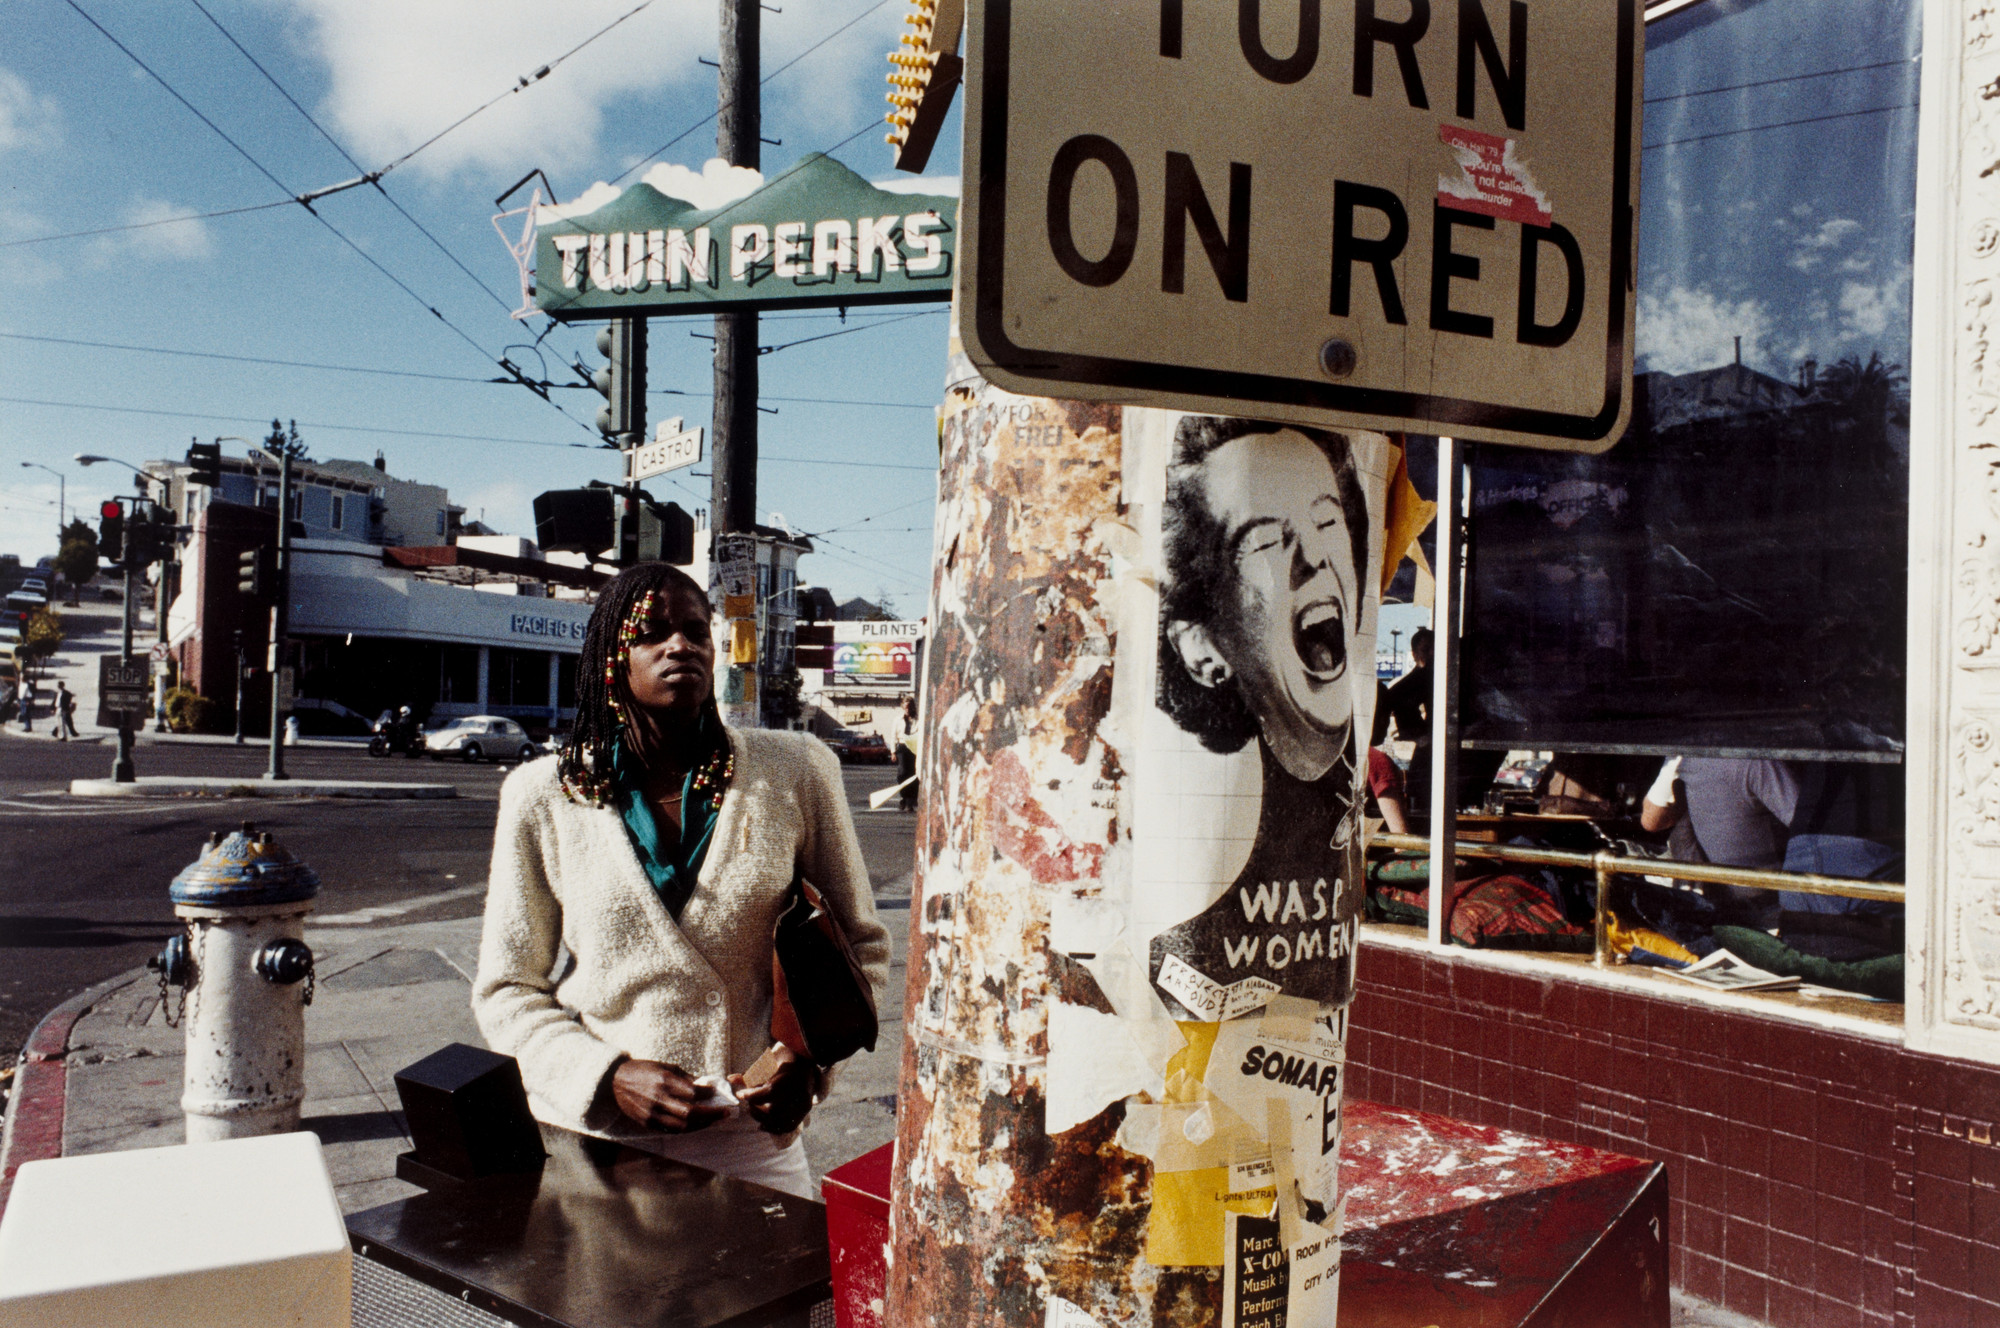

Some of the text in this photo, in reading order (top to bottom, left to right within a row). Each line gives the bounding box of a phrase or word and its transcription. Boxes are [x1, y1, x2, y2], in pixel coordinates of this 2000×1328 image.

[1478, 175, 1496, 189] not
[551, 211, 942, 291] TWIN PEAKS
[1046, 133, 1586, 348] ON RED
[641, 438, 693, 470] CASTRO
[511, 614, 569, 638] PACIFIC
[862, 624, 917, 636] PLANTS
[109, 668, 142, 683] STOP
[1239, 876, 1343, 925] WASP
[1222, 921, 1351, 971] WOMEN
[1242, 1237, 1273, 1253] Marc
[1295, 1241, 1321, 1261] ROOM
[1241, 1273, 1277, 1295] Musik
[1303, 1272, 1322, 1292] CITY
